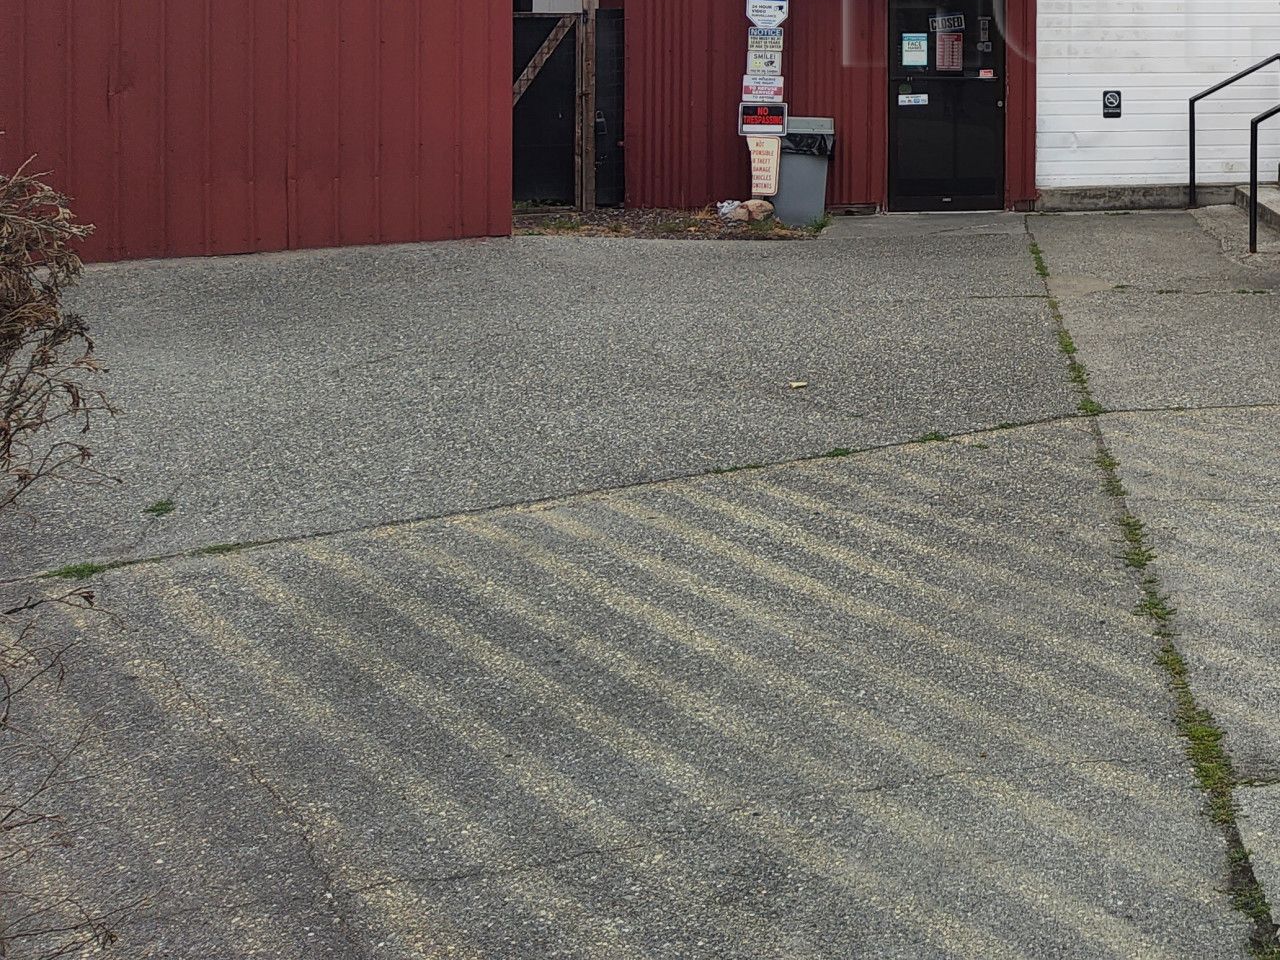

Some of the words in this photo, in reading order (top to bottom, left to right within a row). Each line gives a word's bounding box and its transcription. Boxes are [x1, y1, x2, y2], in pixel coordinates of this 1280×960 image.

[930, 16, 963, 31] CLOSED
[757, 107, 768, 115] NO
[743, 115, 783, 124] TRESPASSING
